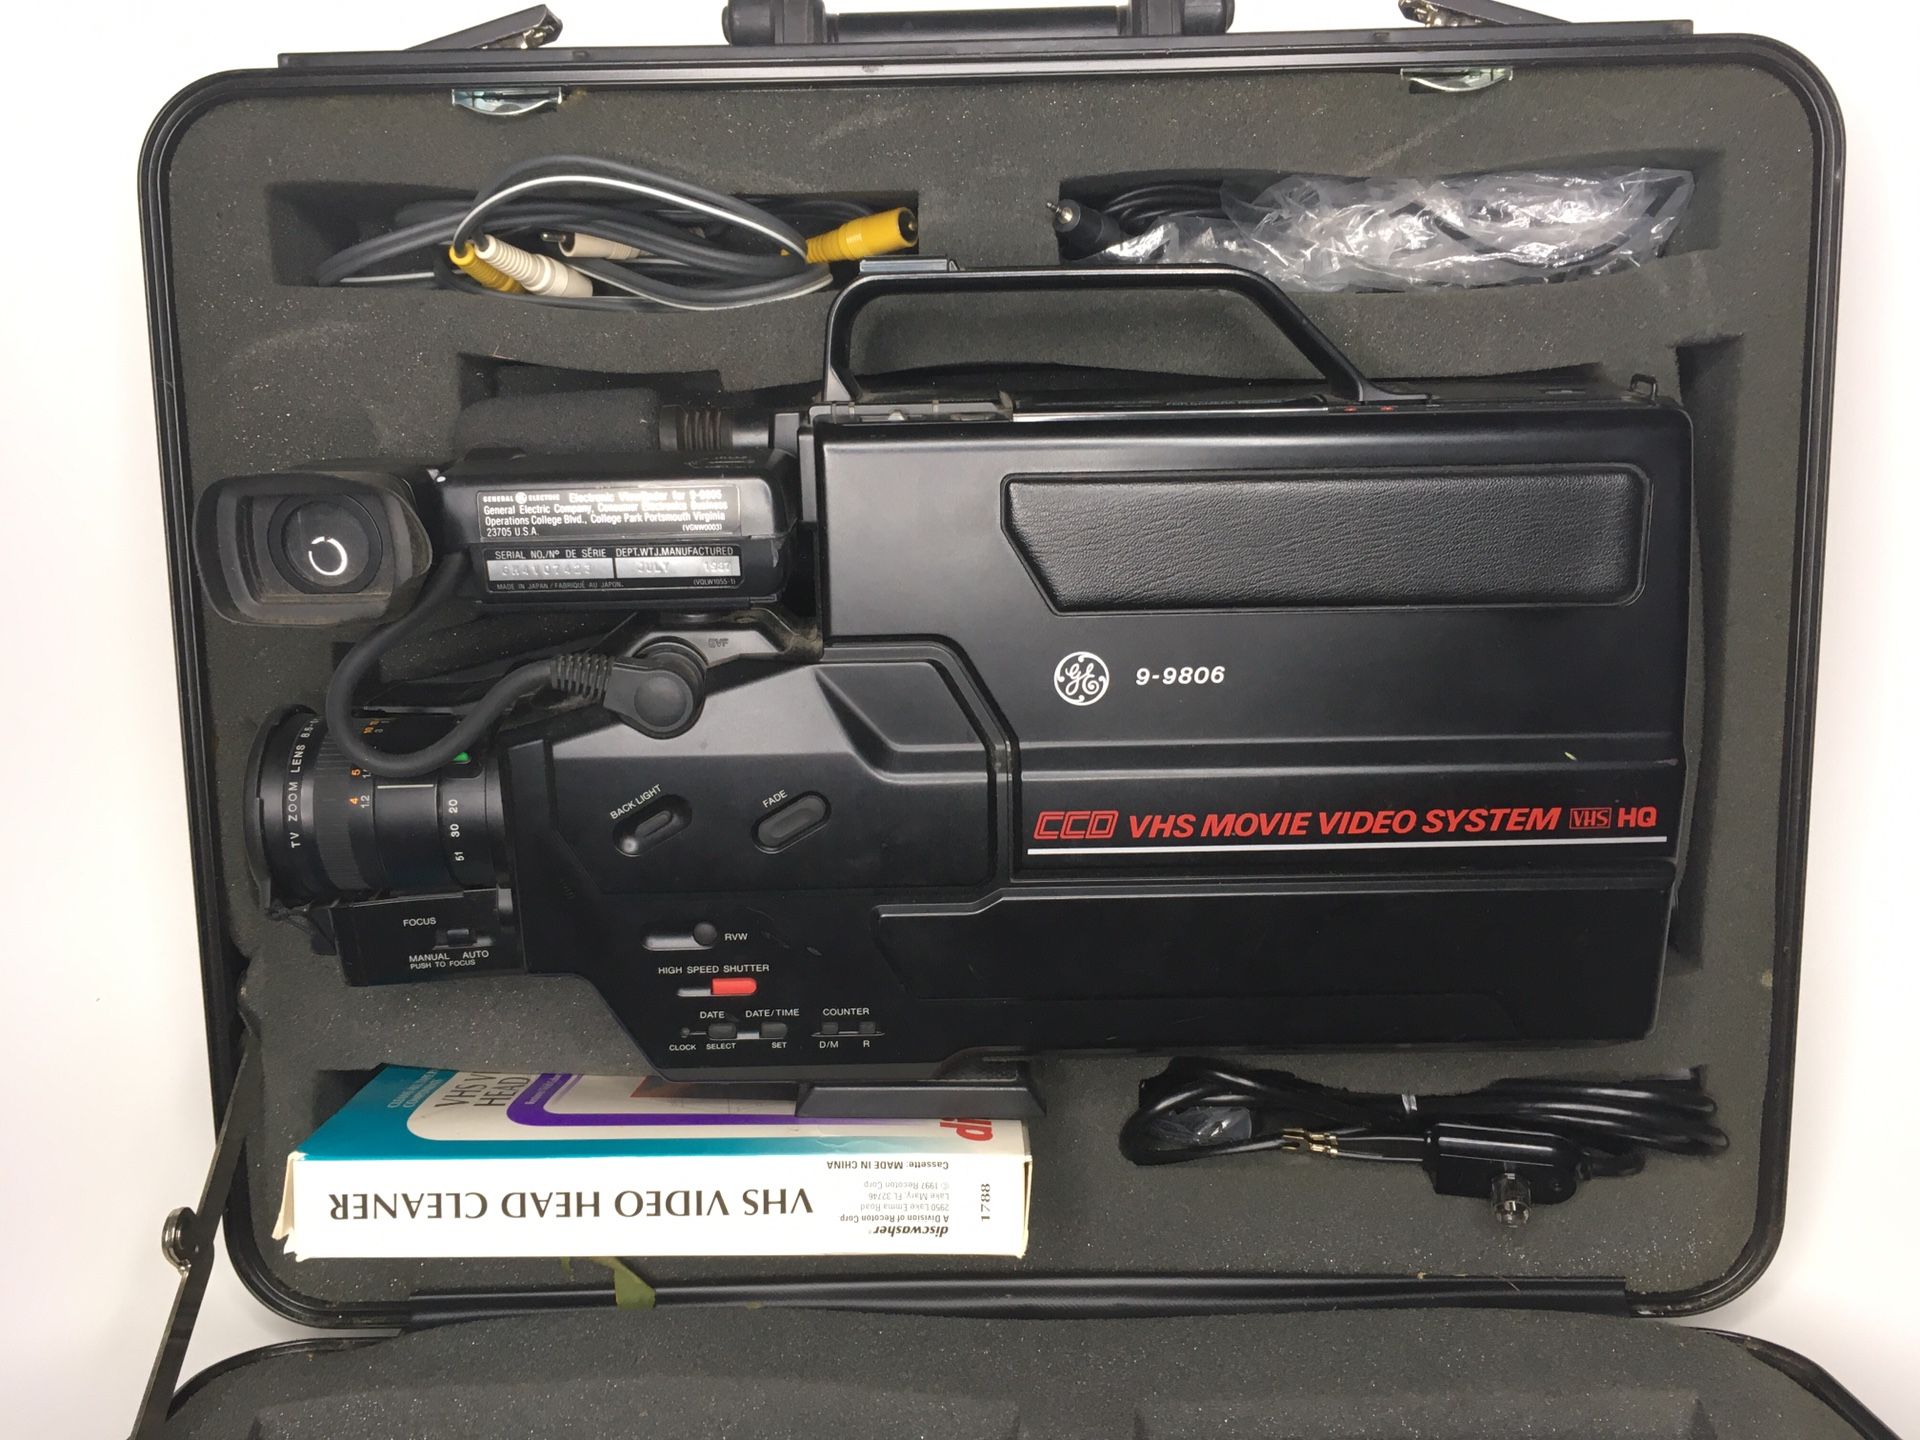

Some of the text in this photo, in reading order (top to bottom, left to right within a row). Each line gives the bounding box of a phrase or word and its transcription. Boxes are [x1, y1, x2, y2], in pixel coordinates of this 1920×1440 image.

[484, 505, 515, 516] General
[520, 504, 550, 514] Electric
[485, 516, 530, 526] Operations
[531, 514, 562, 526] College
[590, 514, 622, 526] College
[624, 513, 642, 522] Park
[644, 512, 692, 522] Portsmouth
[692, 512, 726, 523] Virginia
[487, 527, 540, 537] 23705 U.S.A.
[495, 550, 526, 560] SERIAL
[566, 549, 576, 558] DE
[582, 547, 606, 558] SÉRIE
[638, 562, 669, 573] JULY
[1135, 666, 1226, 686] 9-9806
[290, 744, 306, 774] LENS
[351, 768, 360, 776] 5
[288, 782, 298, 822] ZOOM
[610, 784, 662, 820] BACK LIGHT
[762, 789, 788, 808] FADE
[448, 798, 458, 814] 20
[1034, 806, 1657, 840] CCD VHS MOVIE VIDEO SYSTEM VHS HQ
[450, 824, 460, 838] 30
[291, 832, 301, 848] TV
[454, 851, 464, 861] 51
[403, 916, 436, 926] FOCUS
[724, 932, 748, 941] RVW
[409, 949, 490, 962] MANUAL AUTO
[410, 958, 476, 970] PUSH TO FOCUS
[658, 964, 770, 974] HIGH SPEED SHUTTER
[700, 1010, 724, 1019] DATE
[746, 1008, 800, 1018] DATE/TIME
[822, 1008, 870, 1016] COUNTER
[819, 1040, 839, 1048] D/M
[434, 1084, 488, 1108] VHS
[474, 1076, 531, 1107] HEAD
[826, 1160, 949, 1169] Cassette: MADE IN CHINA
[885, 1182, 919, 1190] Recoton
[328, 1188, 814, 1220] VHS VIDEO HEAD CLEANER
[980, 1183, 991, 1222] 1788
